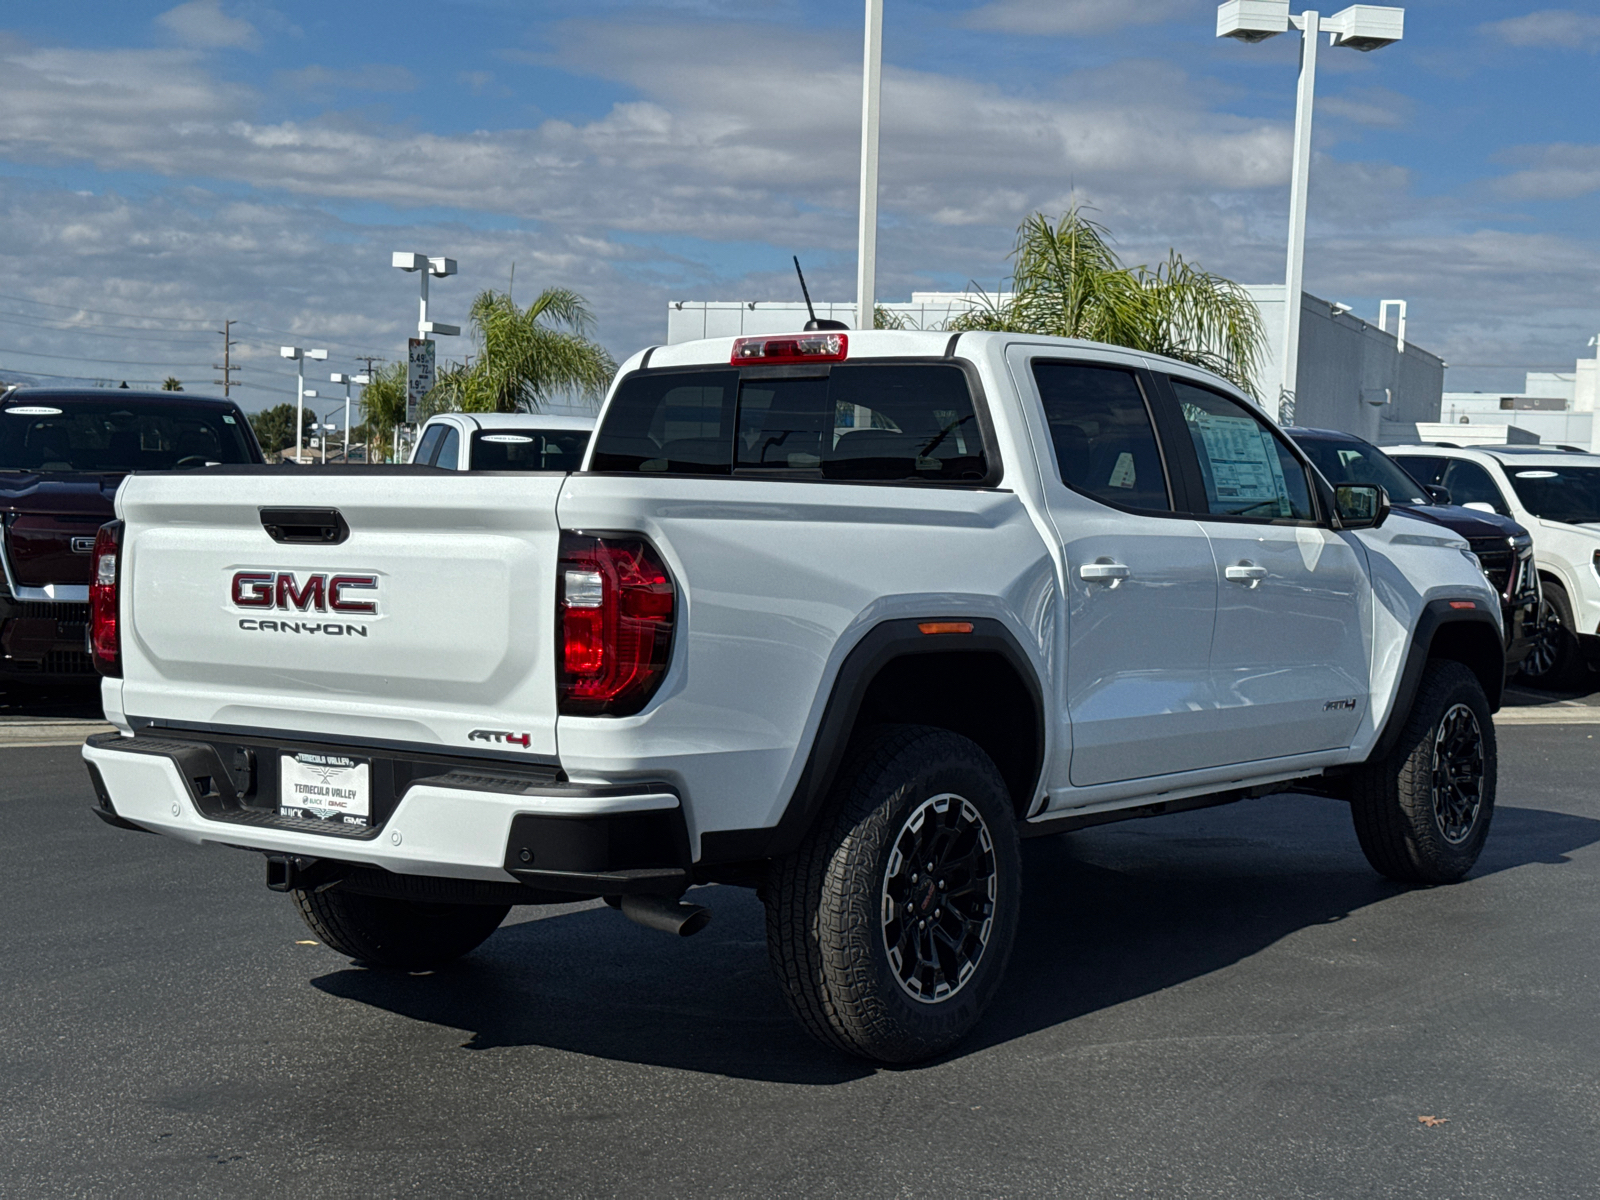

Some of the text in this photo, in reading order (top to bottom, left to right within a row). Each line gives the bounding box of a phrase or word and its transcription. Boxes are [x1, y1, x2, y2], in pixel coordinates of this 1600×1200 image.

[232, 570, 378, 615] GMC
[239, 619, 368, 637] CANYON
[467, 729, 532, 749] AT4
[298, 752, 350, 766] TEMECULA VALLEY
[294, 783, 357, 800] TEMECULA VALLEY
[343, 816, 367, 827] GMC
